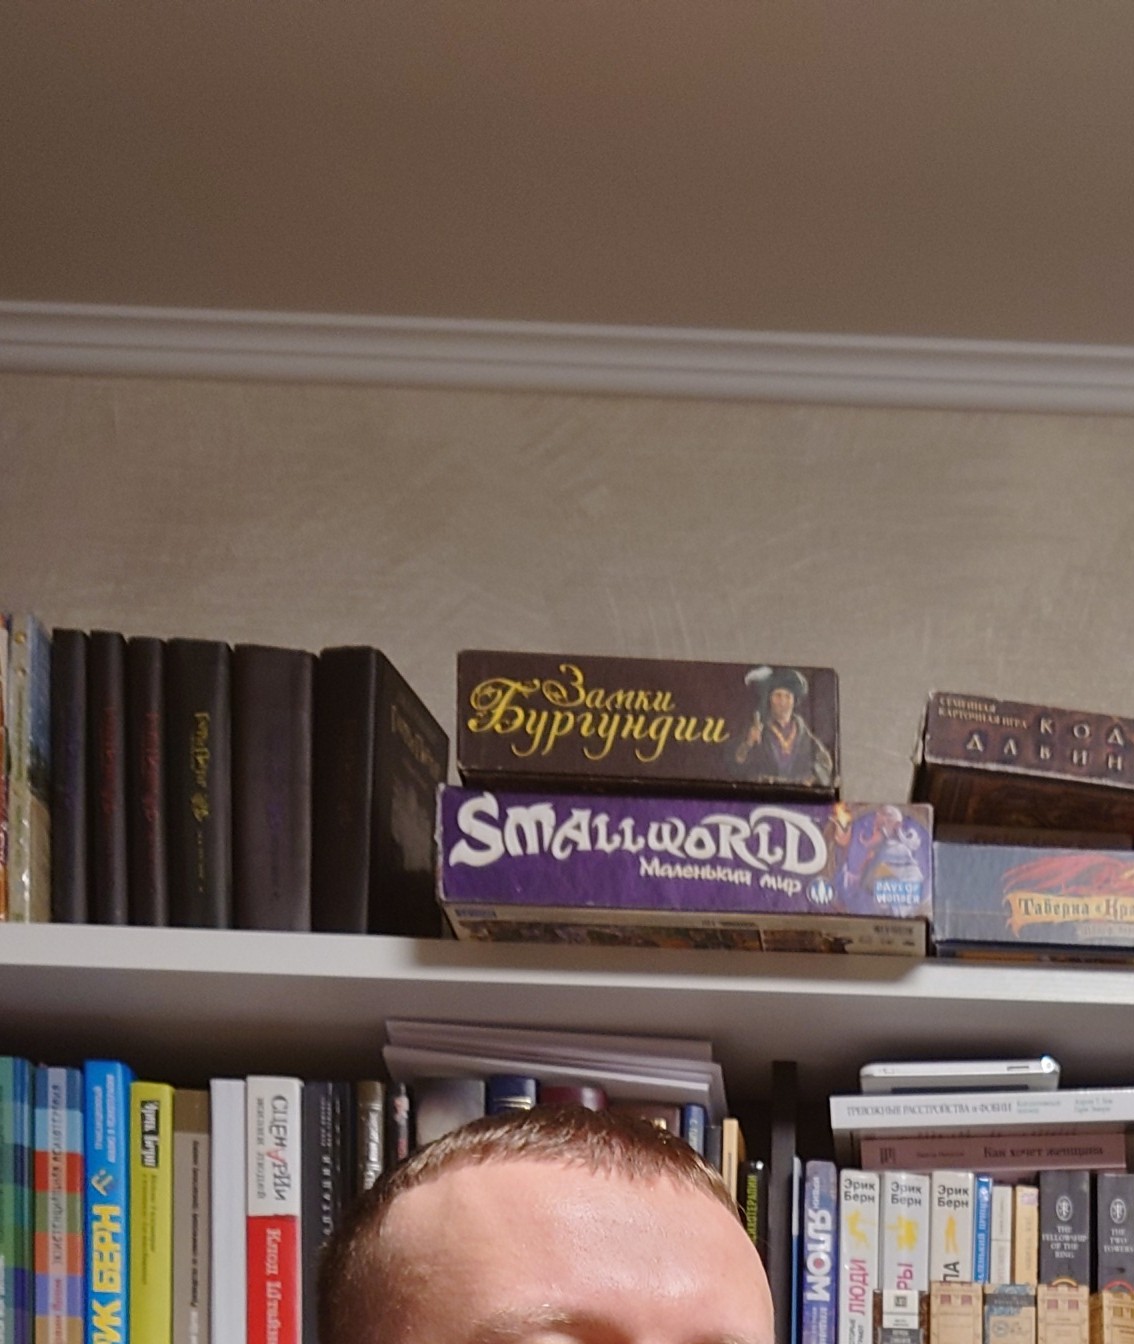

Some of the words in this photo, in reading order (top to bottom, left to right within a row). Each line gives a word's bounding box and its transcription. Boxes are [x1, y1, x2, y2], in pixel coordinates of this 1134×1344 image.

[542, 664, 675, 711] Замки
[467, 677, 731, 762] Бургундии
[1039, 717, 1125, 748] КОД
[639, 855, 752, 888] Маленький
[760, 872, 803, 896] мир
[1018, 898, 1089, 917] Таверна
[983, 1146, 1007, 1158] Как
[1009, 1146, 1044, 1158] хочет
[843, 1178, 876, 1193] Эрик
[890, 1180, 922, 1195] Эрик
[937, 1184, 970, 1199] Эрик
[843, 1189, 876, 1205] Берн
[890, 1192, 922, 1208] Берн
[937, 1195, 969, 1210] Берн
[746, 1175, 758, 1244] СИХОТЕРАПИИ
[1057, 1226, 1073, 1234] THE
[1111, 1228, 1127, 1236] THE
[92, 1203, 122, 1294] БЕРН
[1050, 1242, 1062, 1250] OF
[1063, 1242, 1079, 1251] THE
[1109, 1236, 1128, 1245] TWO
[265, 1228, 281, 1276] Клод
[806, 1209, 833, 1302] ЯЛОМ
[1055, 1251, 1075, 1259] RING
[1103, 1245, 1134, 1253] TOWERS
[846, 1258, 870, 1317] ЛЮДИ
